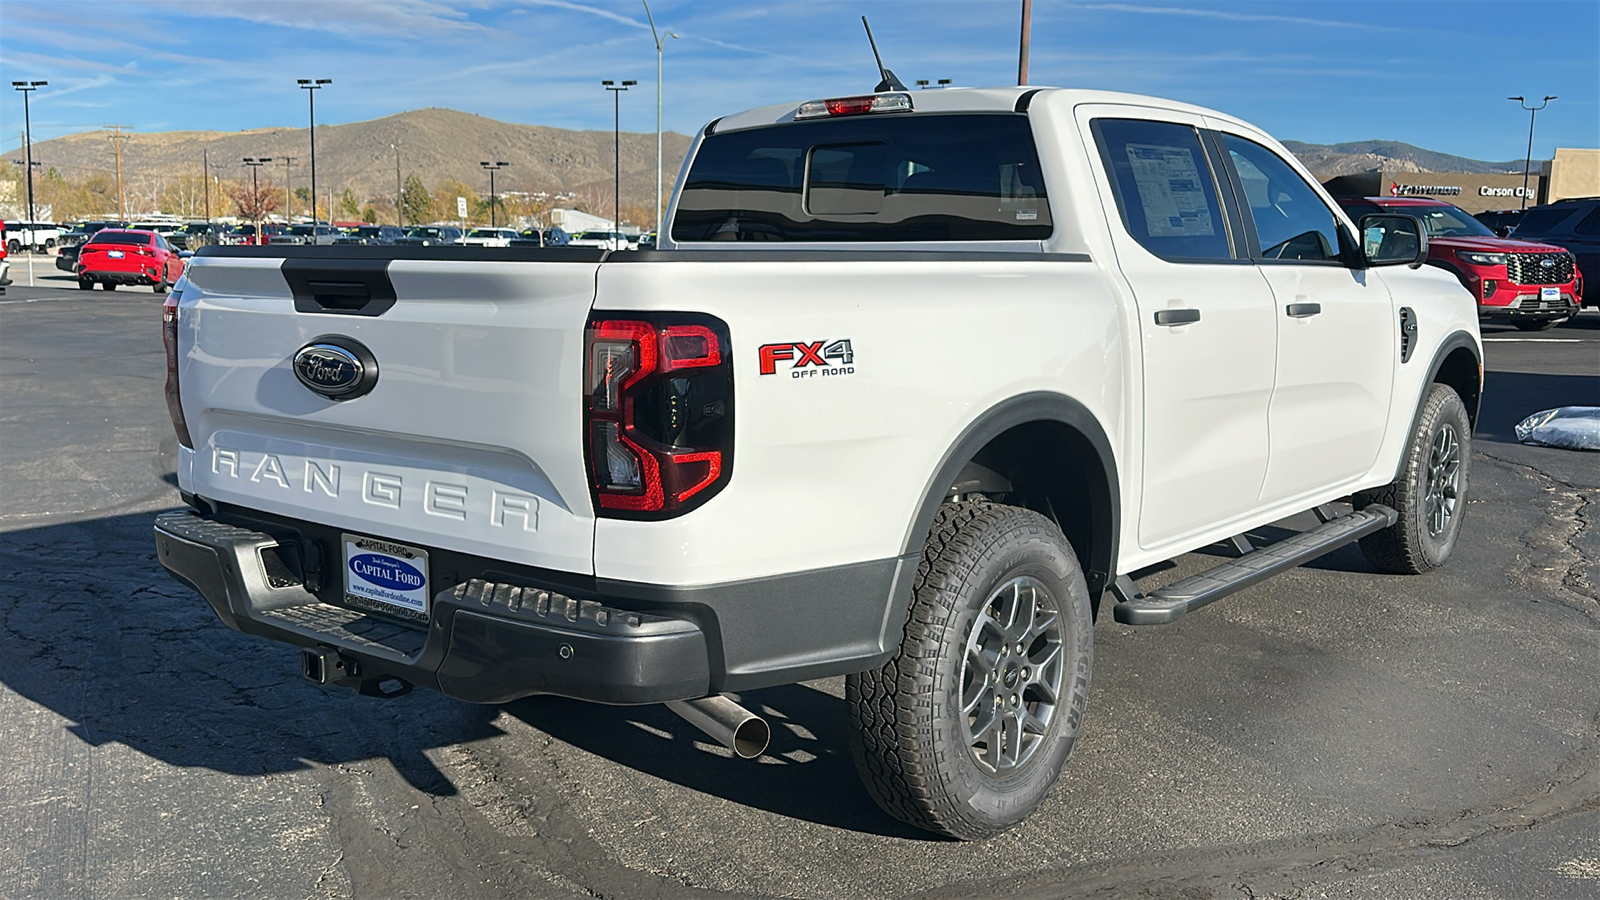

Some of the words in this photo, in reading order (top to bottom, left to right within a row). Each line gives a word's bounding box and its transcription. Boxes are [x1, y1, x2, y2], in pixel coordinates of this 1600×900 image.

[1480, 185, 1514, 197] Carson
[1515, 186, 1535, 200] City
[306, 352, 343, 382] Ford
[758, 338, 854, 376] FX4
[791, 369, 818, 379] OFF
[822, 366, 855, 377] ROAD
[211, 447, 541, 533] RANGER
[360, 538, 388, 552] CAPITAL
[388, 544, 409, 556] FORD
[1065, 574, 1090, 731] WRANGLER
